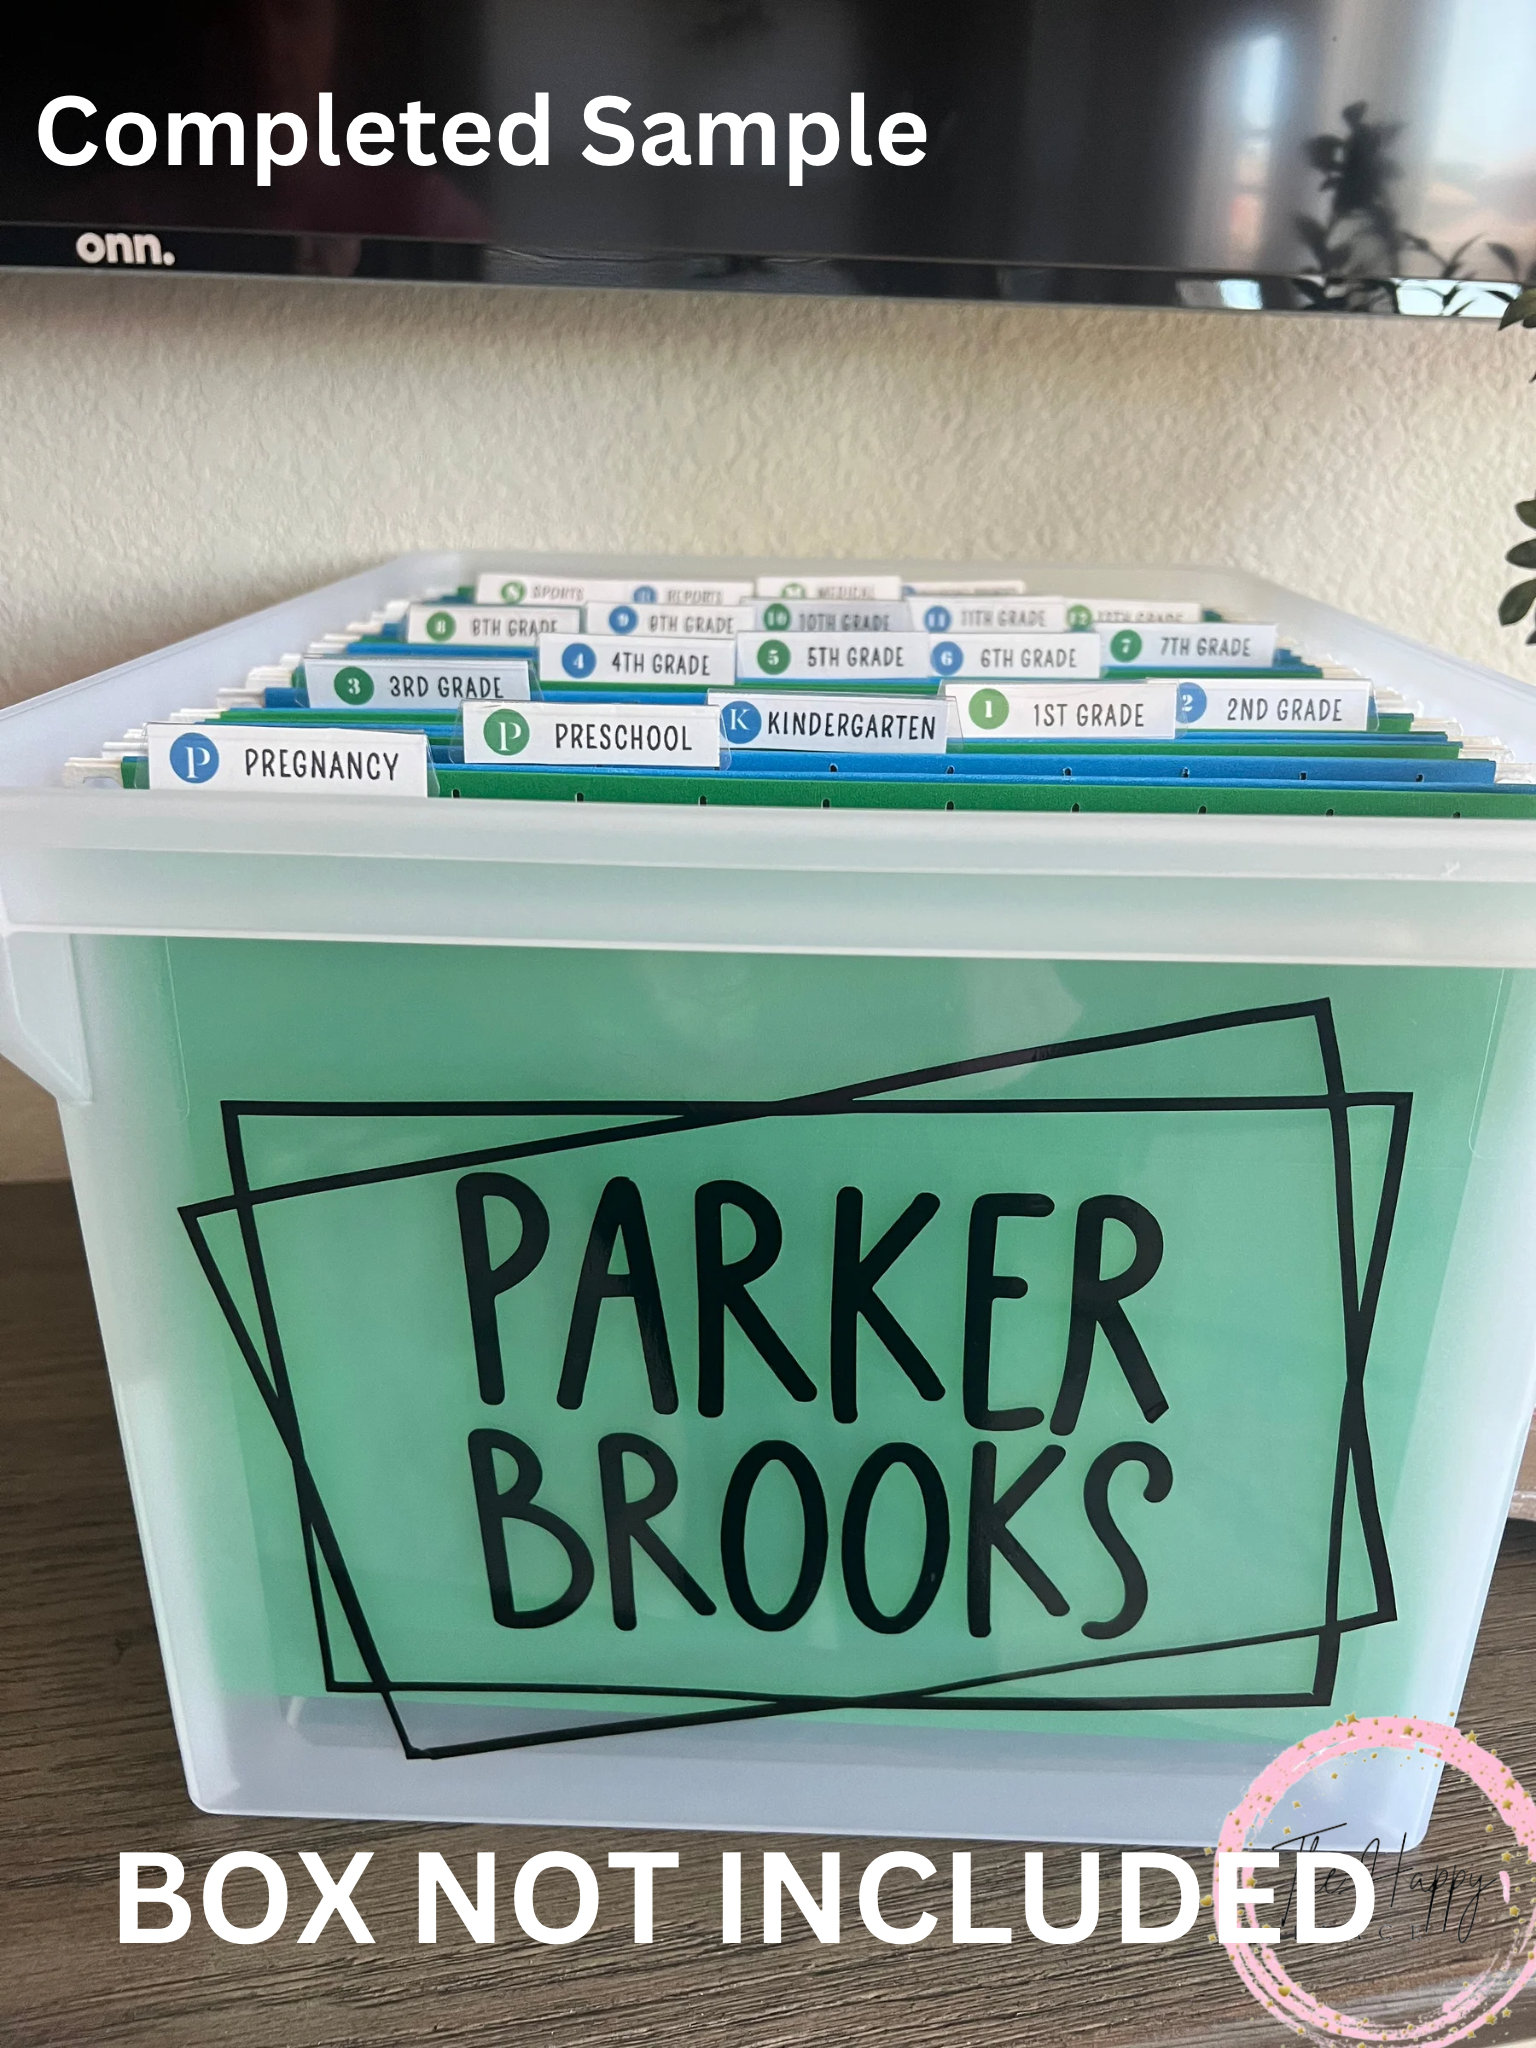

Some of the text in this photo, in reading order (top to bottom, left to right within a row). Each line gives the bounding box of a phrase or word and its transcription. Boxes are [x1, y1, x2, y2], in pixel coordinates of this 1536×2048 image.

[76, 232, 175, 266] onn.
[532, 585, 584, 601] SPORTS
[508, 620, 558, 638] GRADE
[684, 616, 734, 634] GRADE
[799, 613, 836, 631] 10TH
[841, 614, 890, 631] GRADE
[961, 609, 994, 627] 11TH
[998, 610, 1046, 627] GRADE
[767, 647, 904, 668] 5 5TH GRADE
[941, 648, 1077, 669] 6 6TH GRADE
[1120, 637, 1251, 657] 7 7TH GRADE
[573, 652, 711, 676] 4 4TH GRADE
[348, 676, 504, 699] 3 3RD GRADE
[1034, 704, 1068, 727] 1ST
[1077, 703, 1144, 728] GRADE
[1182, 695, 1343, 722] 2 2ND GRADE
[730, 708, 935, 740] K KINDERGARTEN
[499, 722, 692, 751] P PRESCHOOL
[186, 746, 398, 781] P PREGNANCY
[456, 1172, 1169, 1435] PARKER
[468, 1429, 1173, 1639] BROOKS
